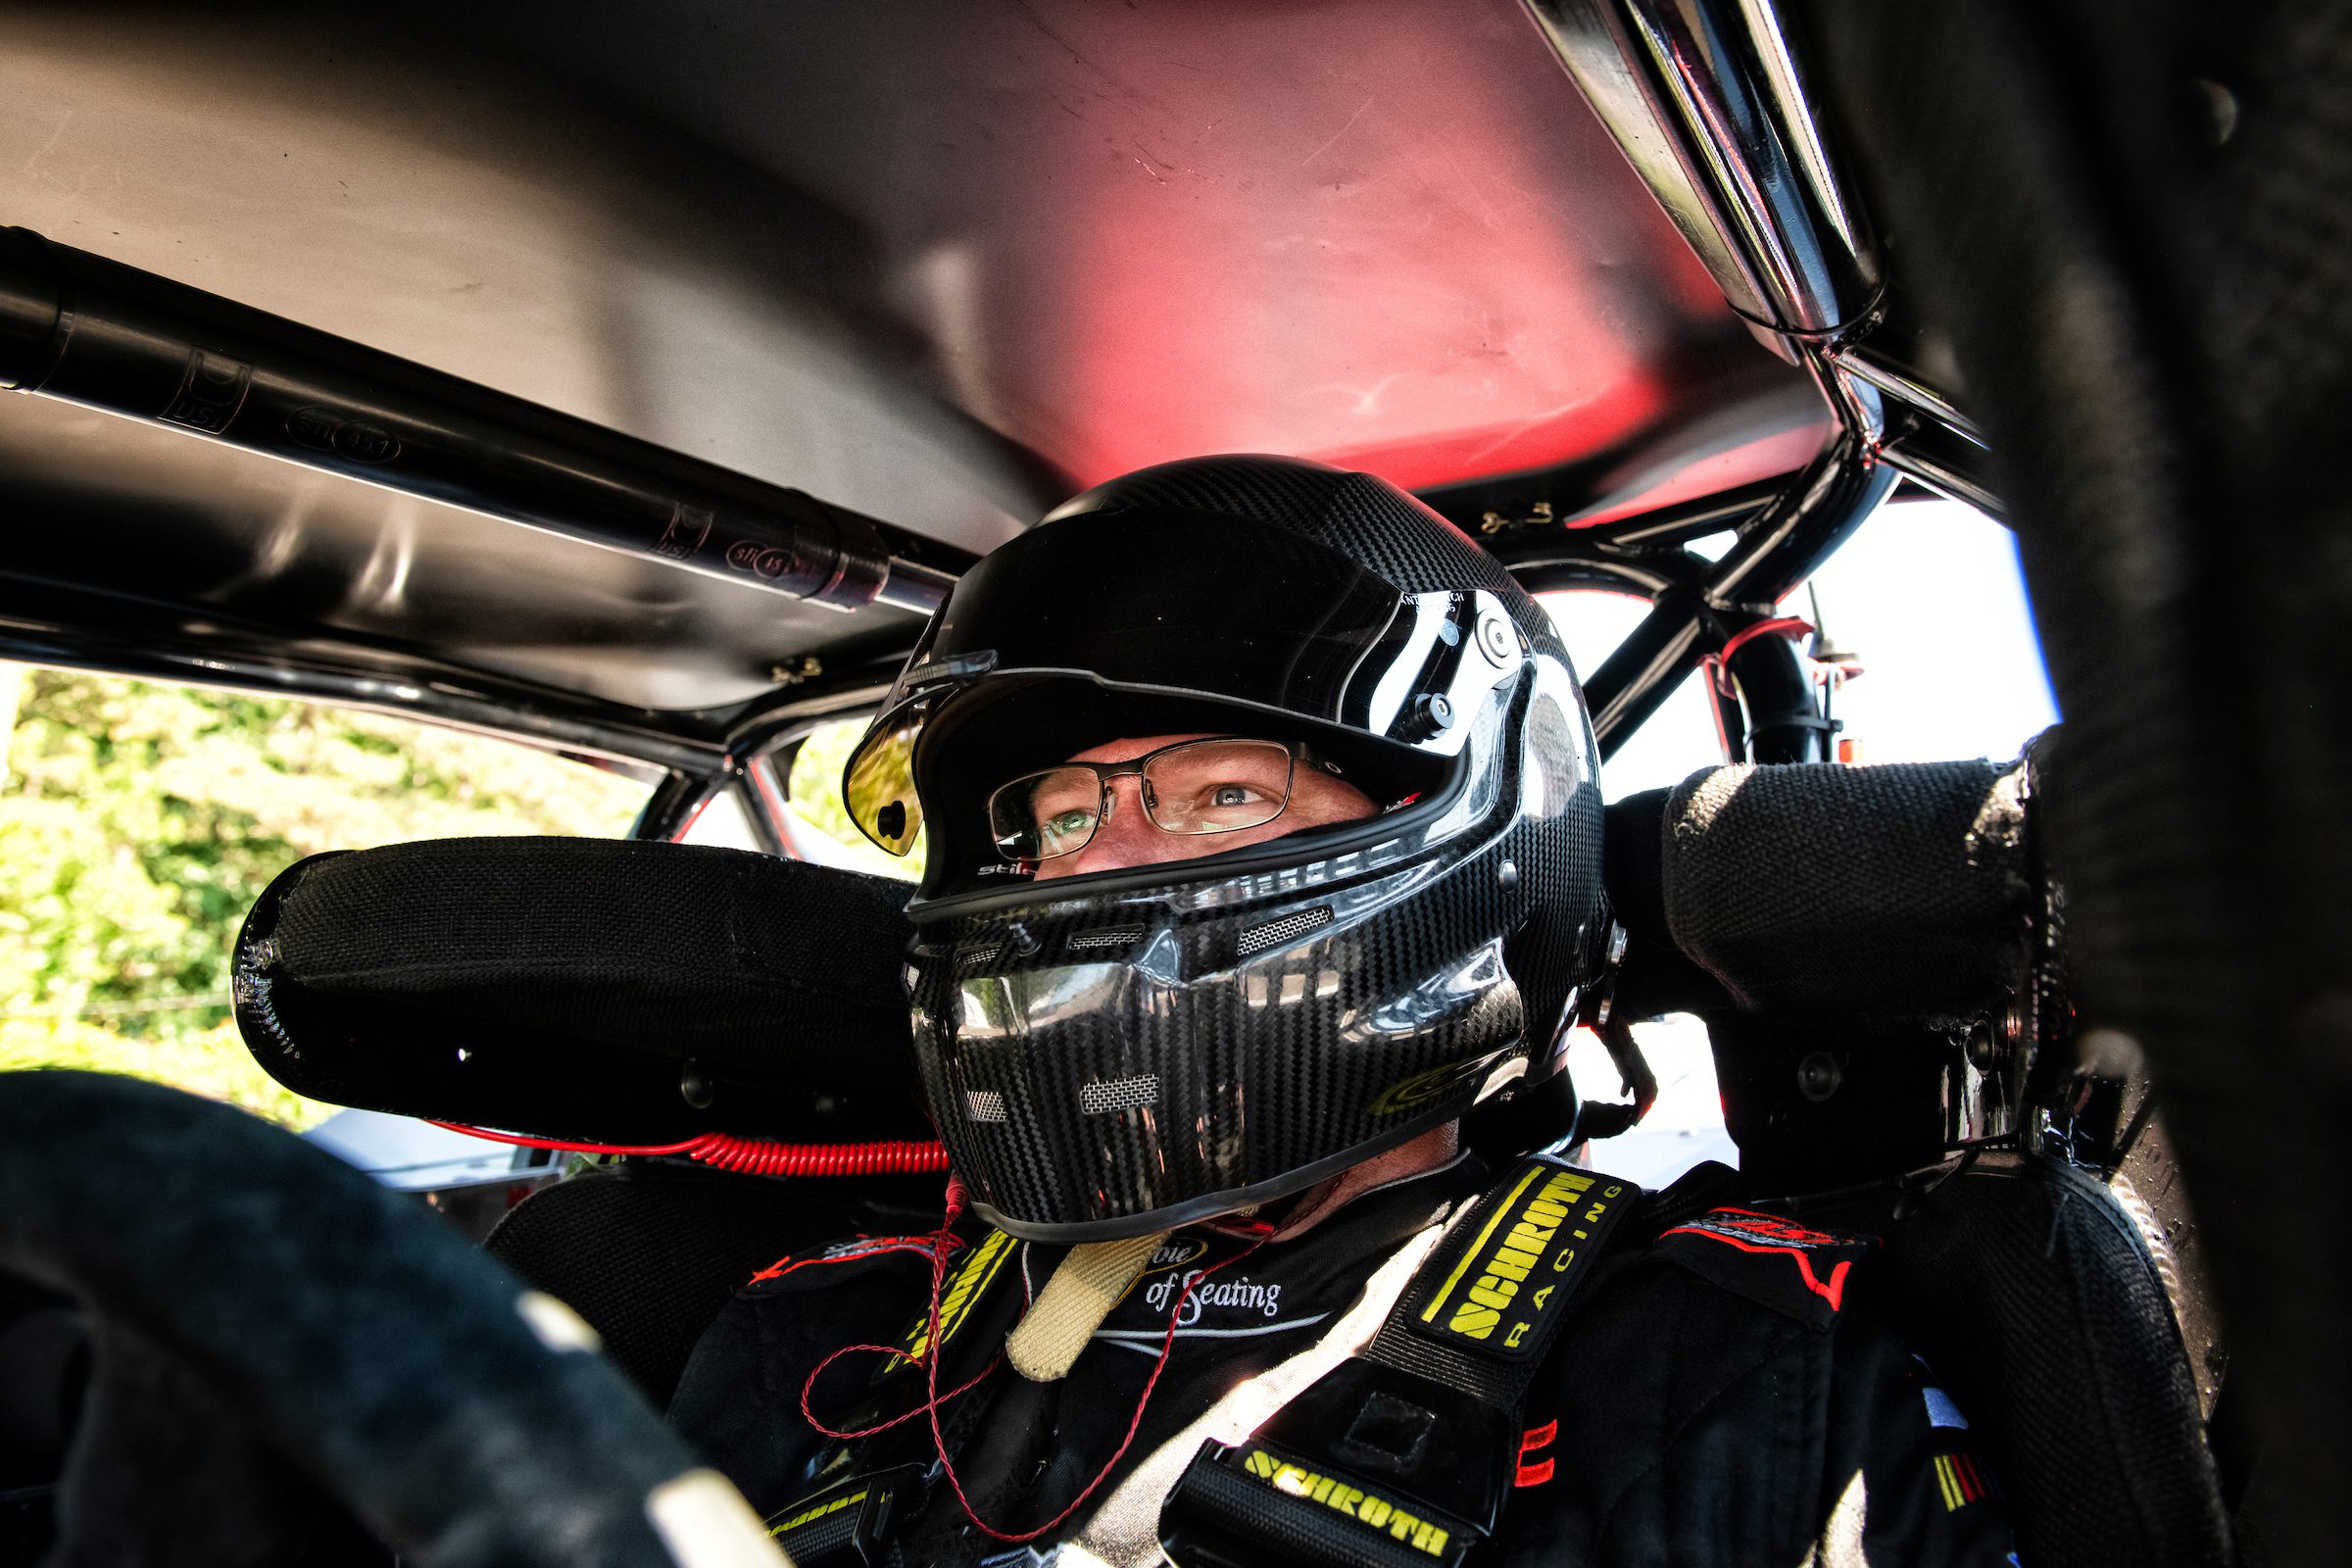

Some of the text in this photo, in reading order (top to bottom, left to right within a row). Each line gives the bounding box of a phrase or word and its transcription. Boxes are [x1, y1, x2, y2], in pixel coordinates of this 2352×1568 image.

[1145, 1268, 1282, 1328] of Seating
[1152, 1242, 1193, 1264] oie
[1449, 1170, 1596, 1340] SCHROTH
[1503, 1184, 1623, 1348] RACING
[1244, 1449, 1451, 1558] SCHROTH
